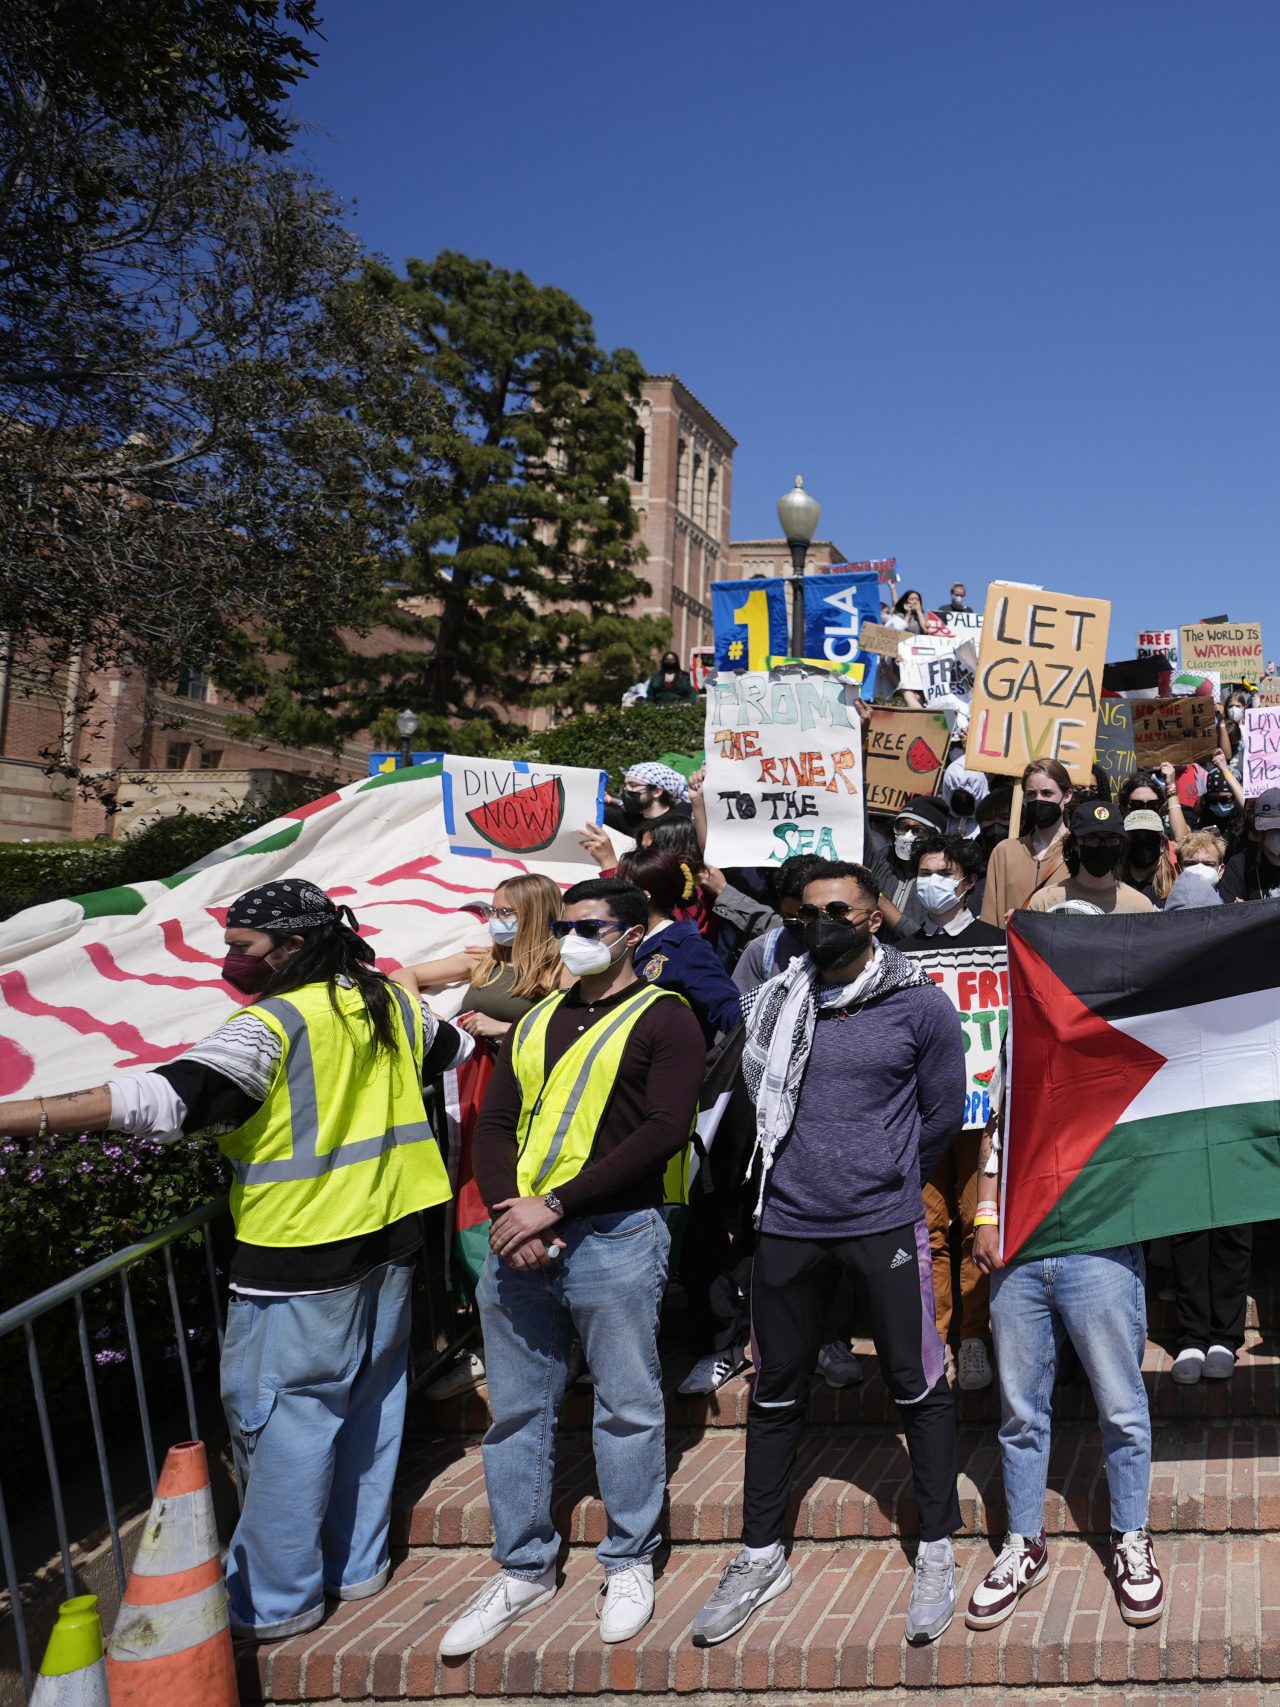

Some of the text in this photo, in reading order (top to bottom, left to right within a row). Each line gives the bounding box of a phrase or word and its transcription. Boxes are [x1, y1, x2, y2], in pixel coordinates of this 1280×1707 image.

[823, 585, 859, 662] CLA
[994, 597, 1096, 651] LET
[1139, 633, 1171, 646] FREE
[1183, 629, 1259, 642] The WORLD IS
[1187, 660, 1238, 669] Claremont
[1193, 644, 1263, 658] WATCHING
[983, 657, 1097, 712] GAZA
[1220, 670, 1259, 684] lidarity
[712, 675, 855, 731] FROM
[713, 729, 763, 761] THE
[977, 708, 1088, 770] LIVE
[464, 769, 562, 801] DIVEST
[757, 748, 858, 794] RIVER
[482, 801, 555, 831] NOW!
[717, 791, 819, 820] TO THE
[767, 822, 839, 862] SEA
[890, 1254, 913, 1269] adidas
